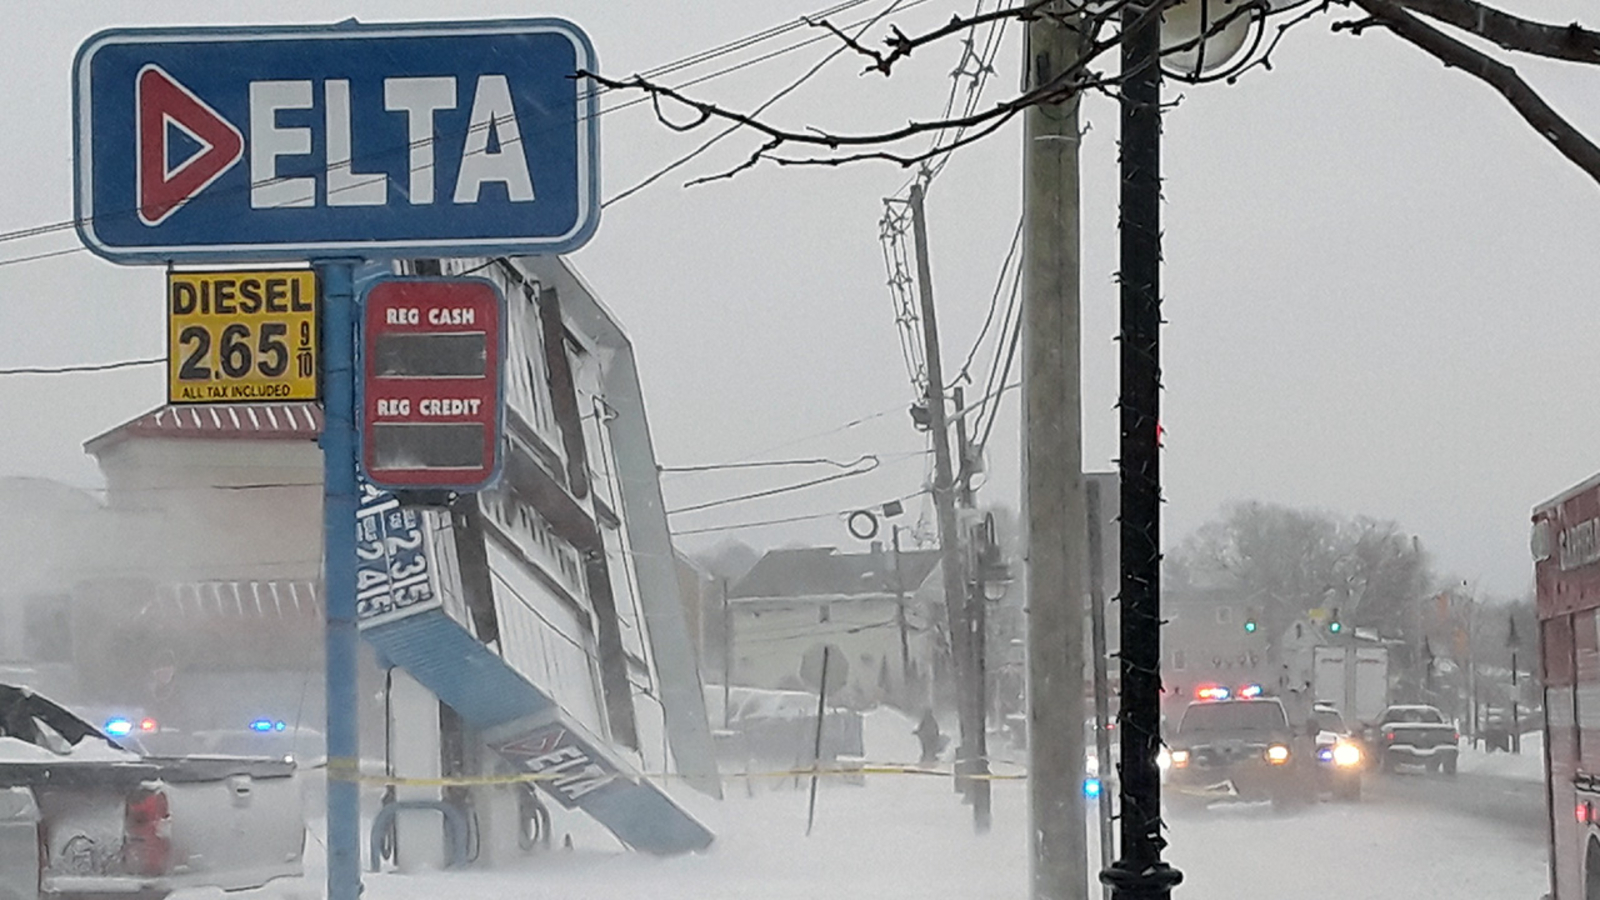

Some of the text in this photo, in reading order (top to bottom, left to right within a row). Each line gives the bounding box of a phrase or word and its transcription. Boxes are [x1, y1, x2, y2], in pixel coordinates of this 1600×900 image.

[173, 279, 312, 314] DIESEL
[386, 308, 475, 324] REG CASH
[178, 323, 288, 380] 2.65
[181, 384, 290, 399] ALL TAX INCLUDED
[377, 399, 481, 416] REG CREDIT
